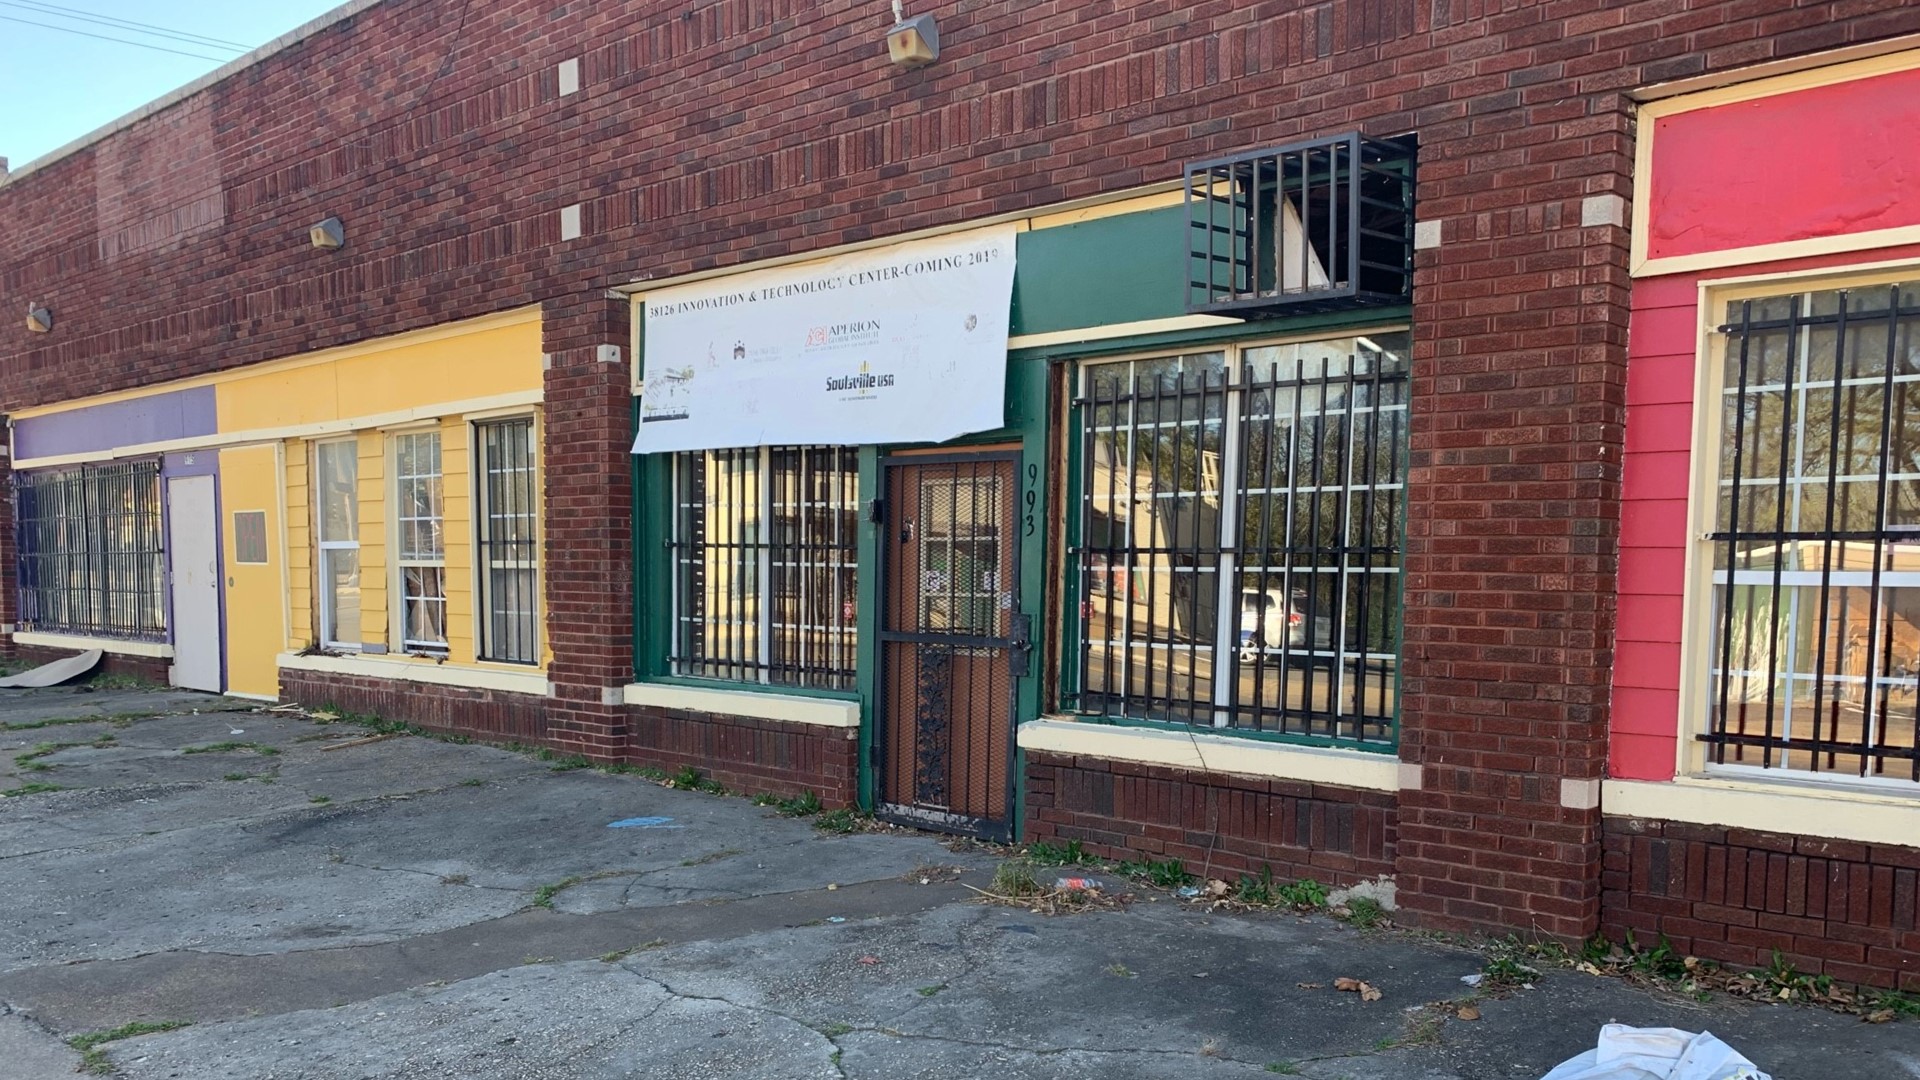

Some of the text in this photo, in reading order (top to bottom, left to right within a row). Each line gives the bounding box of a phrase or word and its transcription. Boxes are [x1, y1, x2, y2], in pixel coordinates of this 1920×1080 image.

[650, 304, 675, 318] 38126
[678, 293, 745, 313] INNOVATION
[748, 290, 758, 302] &
[762, 276, 845, 300] TECHNOLOGY
[826, 373, 876, 391] Soulsville
[1026, 463, 1038, 537] 993
